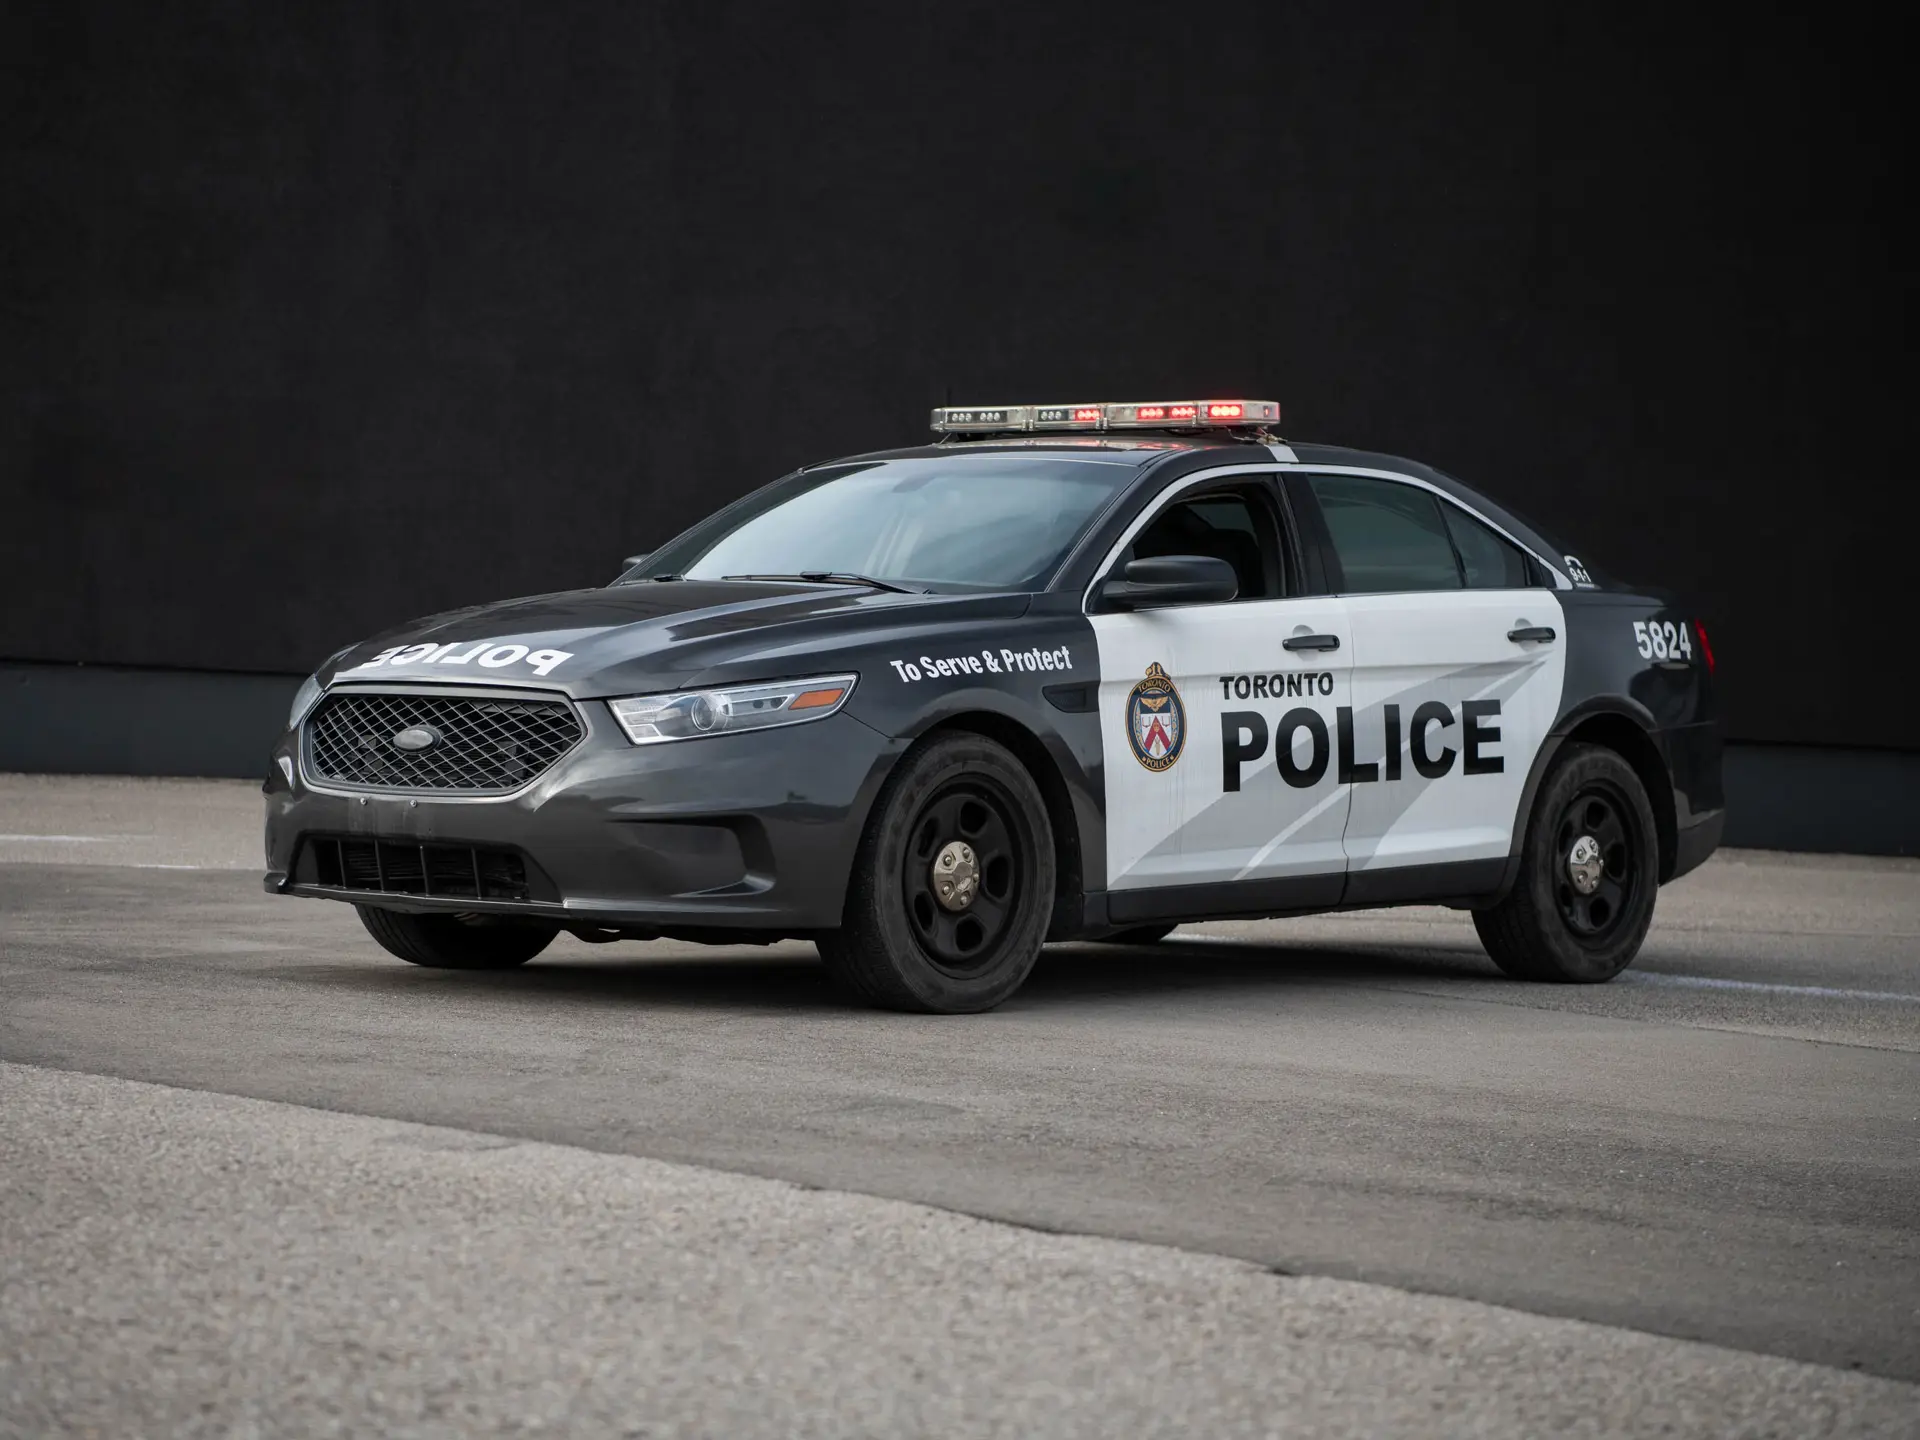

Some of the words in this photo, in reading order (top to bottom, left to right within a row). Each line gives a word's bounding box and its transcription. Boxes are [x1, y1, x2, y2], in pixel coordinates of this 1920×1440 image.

[1632, 620, 1692, 661] 5824
[890, 660, 922, 683] To
[920, 656, 984, 679] Serve
[982, 650, 1004, 673] &
[1000, 645, 1073, 672] Protect
[1138, 678, 1171, 693] TORONTO
[1219, 672, 1334, 700] TORONTO
[1220, 699, 1505, 793] POLICE
[1146, 758, 1170, 769] POLICE
